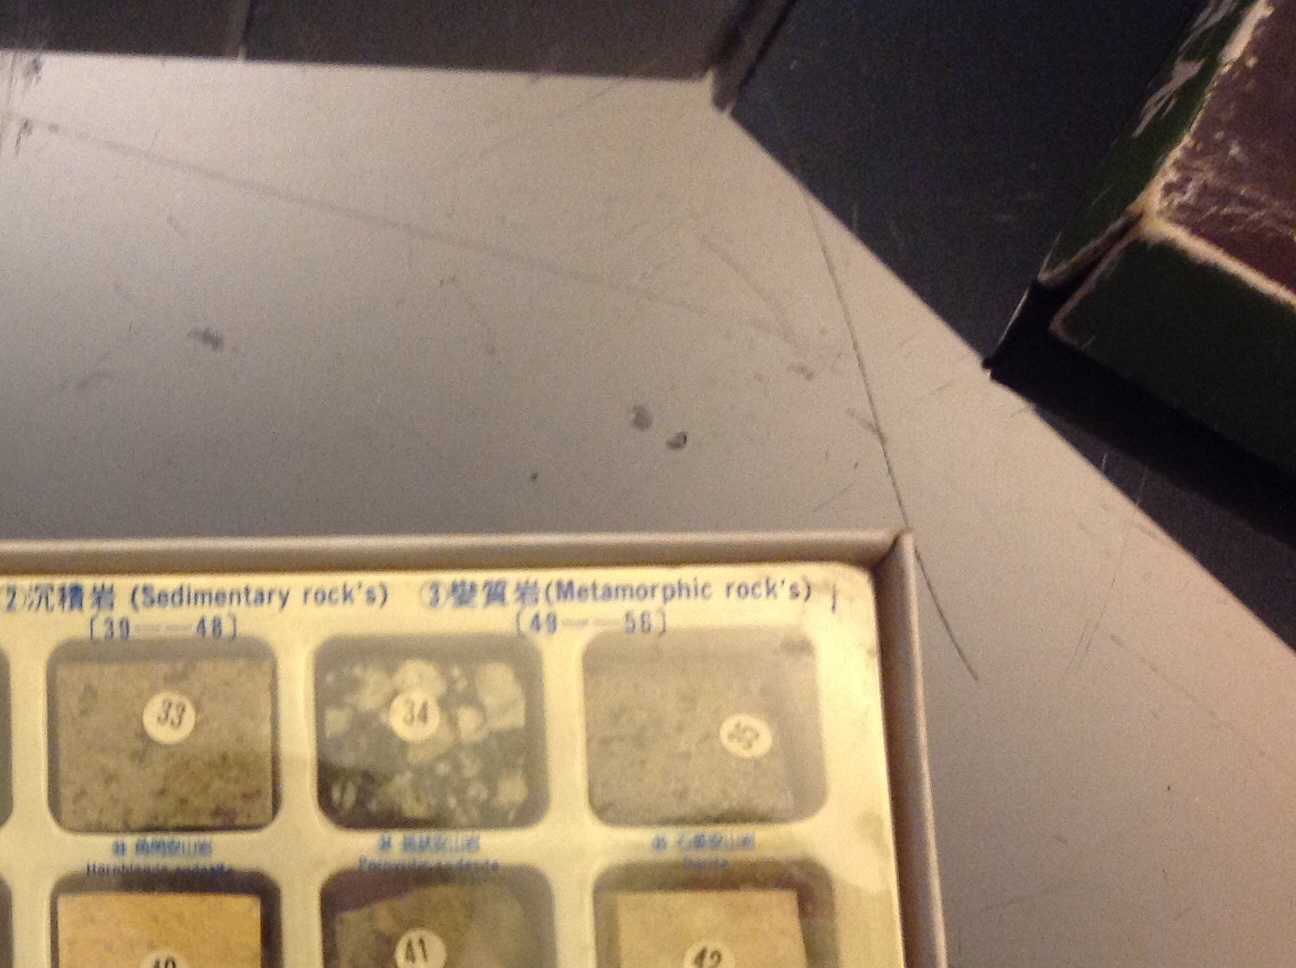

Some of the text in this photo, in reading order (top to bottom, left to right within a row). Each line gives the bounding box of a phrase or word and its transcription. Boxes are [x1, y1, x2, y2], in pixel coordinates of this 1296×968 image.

[302, 582, 390, 609] rock's)
[725, 575, 813, 603] rock's)
[157, 697, 187, 729] 33
[402, 697, 428, 727] 34
[405, 937, 428, 965] 41
